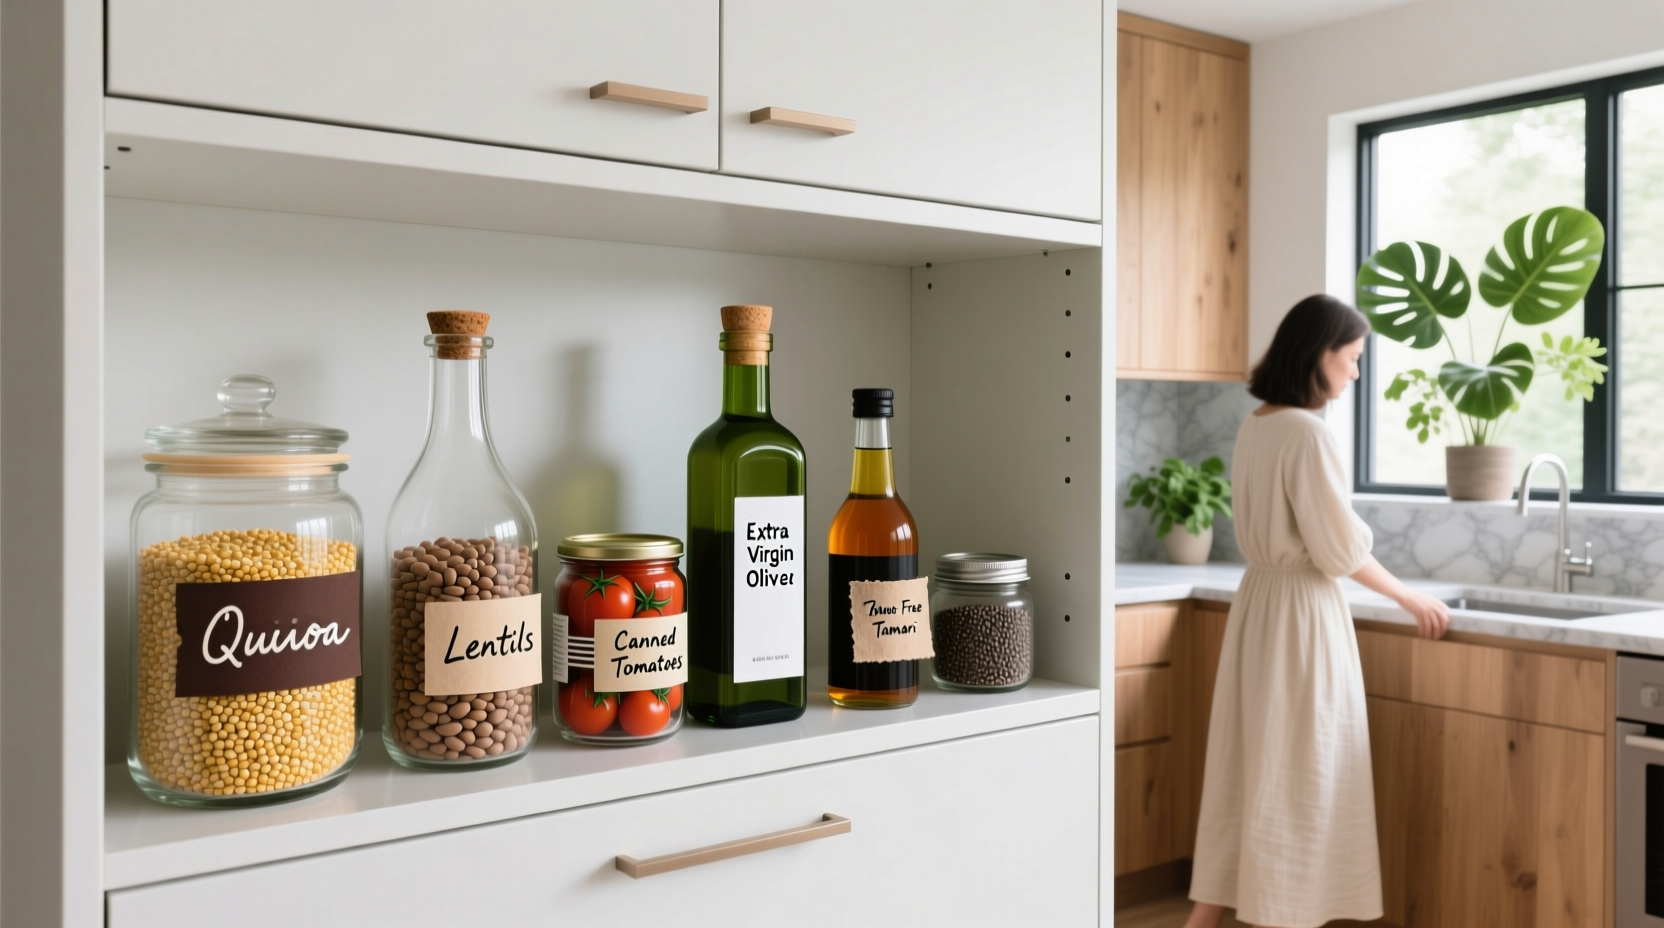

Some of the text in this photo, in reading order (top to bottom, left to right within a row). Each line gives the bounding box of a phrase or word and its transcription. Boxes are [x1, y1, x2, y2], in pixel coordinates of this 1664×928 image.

[747, 522, 789, 541] Extra
[747, 545, 794, 567] Virgin
[614, 626, 677, 651] Canned
[872, 621, 917, 638] Tamari
[444, 621, 533, 664] Lentils
[611, 655, 683, 678] Tomatoes
